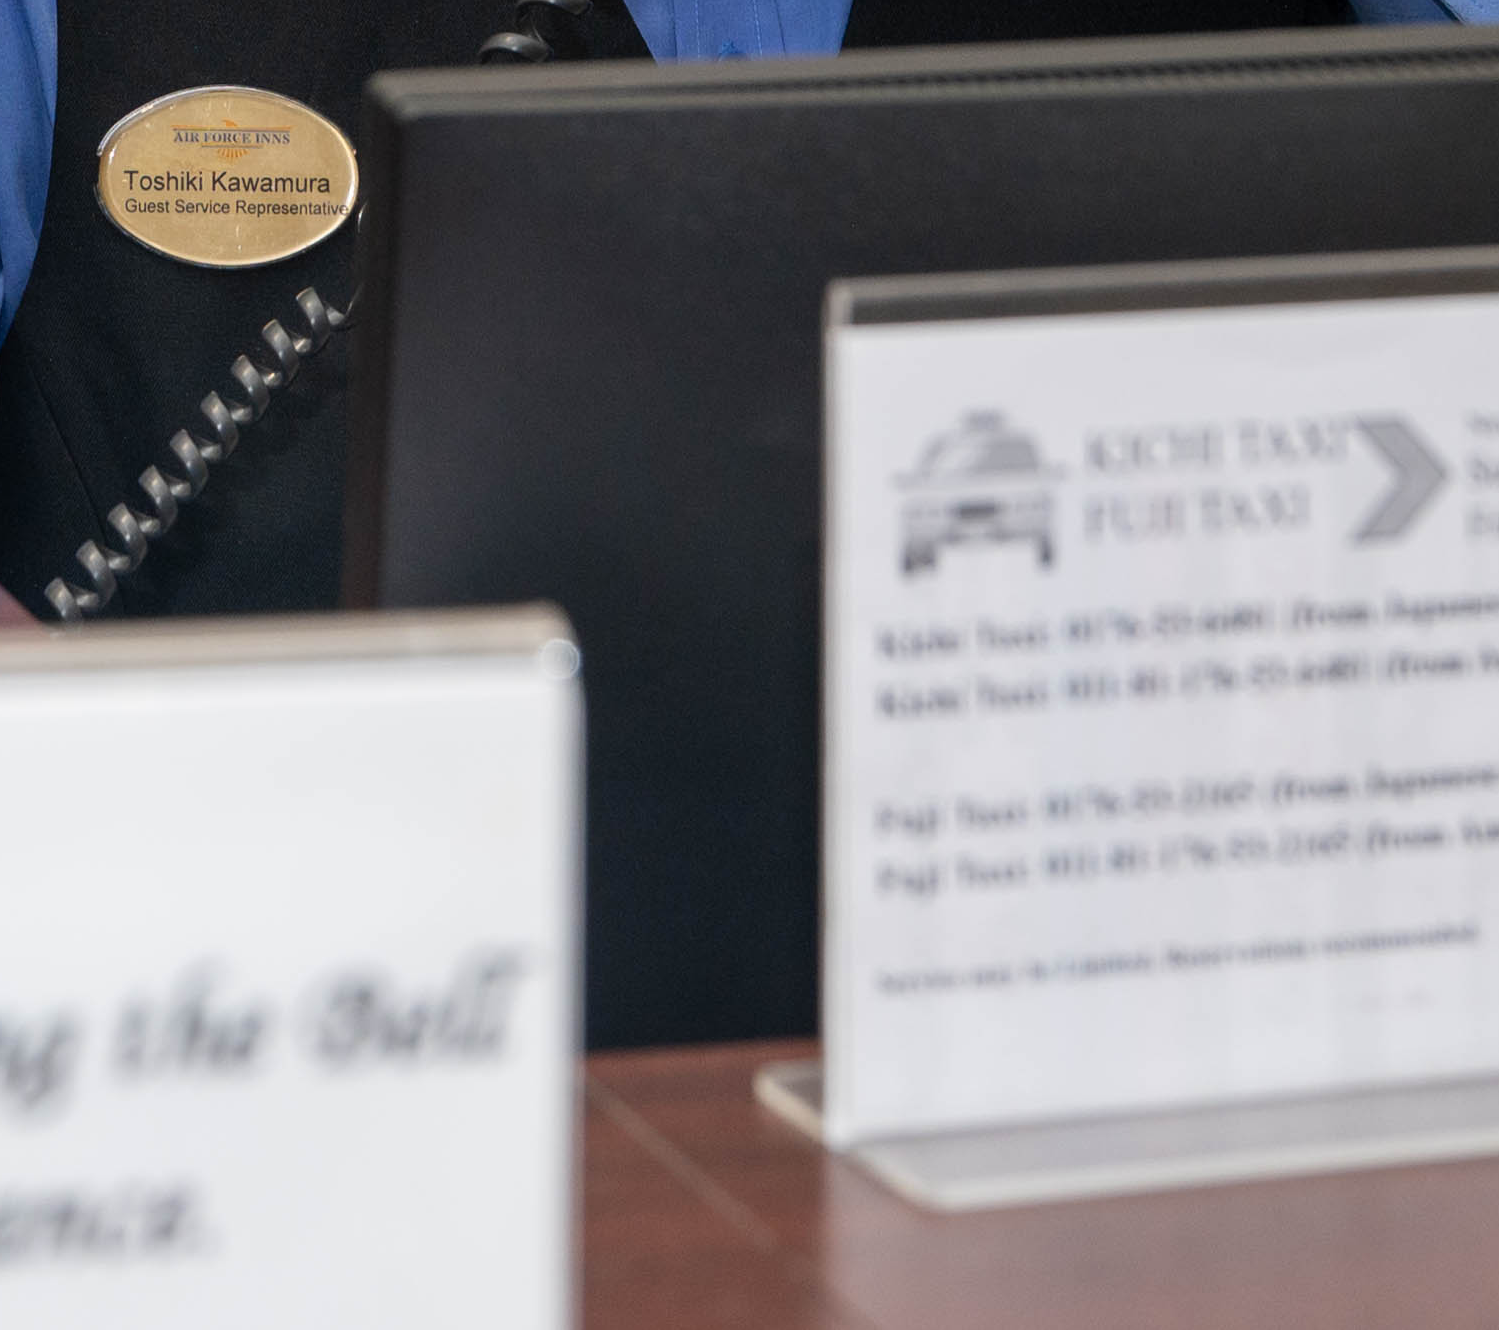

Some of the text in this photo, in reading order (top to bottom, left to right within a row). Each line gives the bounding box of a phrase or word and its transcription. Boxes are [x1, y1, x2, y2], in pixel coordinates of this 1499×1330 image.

[173, 130, 291, 145] AIR FORCE INNS
[124, 170, 330, 193] Toshiki Kawamura
[124, 198, 349, 218] Guest Service Representative
[110, 989, 260, 1085] the
